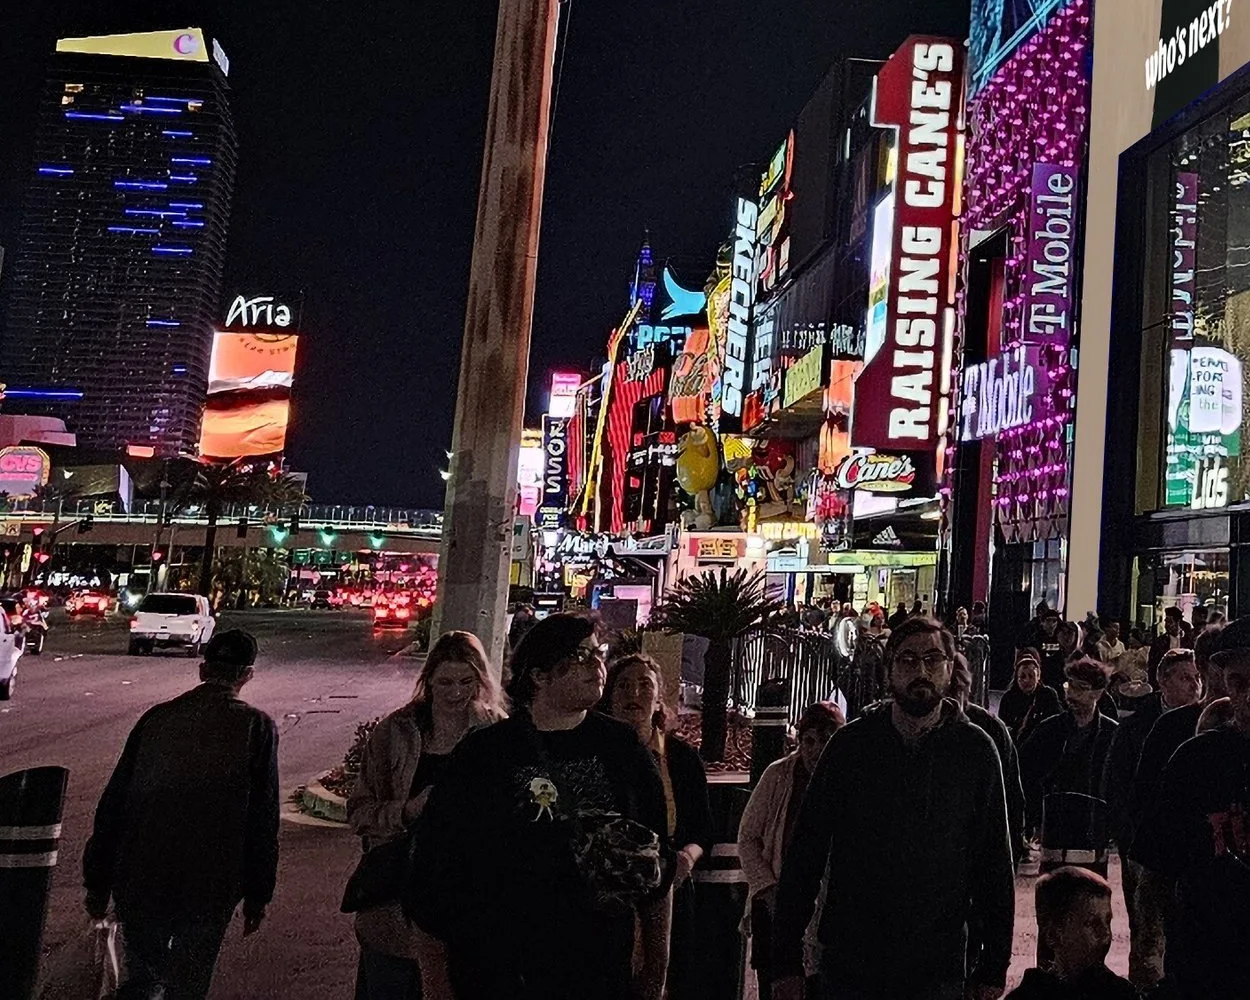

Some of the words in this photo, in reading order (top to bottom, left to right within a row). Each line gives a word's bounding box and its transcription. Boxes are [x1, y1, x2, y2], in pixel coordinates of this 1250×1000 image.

[1145, 25, 1186, 90] who's
[904, 43, 953, 208] CANE'S
[225, 295, 290, 327] Aria
[722, 197, 758, 417] SKECHERS
[888, 226, 943, 440] RAISING
[546, 420, 565, 493] ROSS
[838, 450, 915, 489] Cane's
[1191, 457, 1228, 509] Lids
